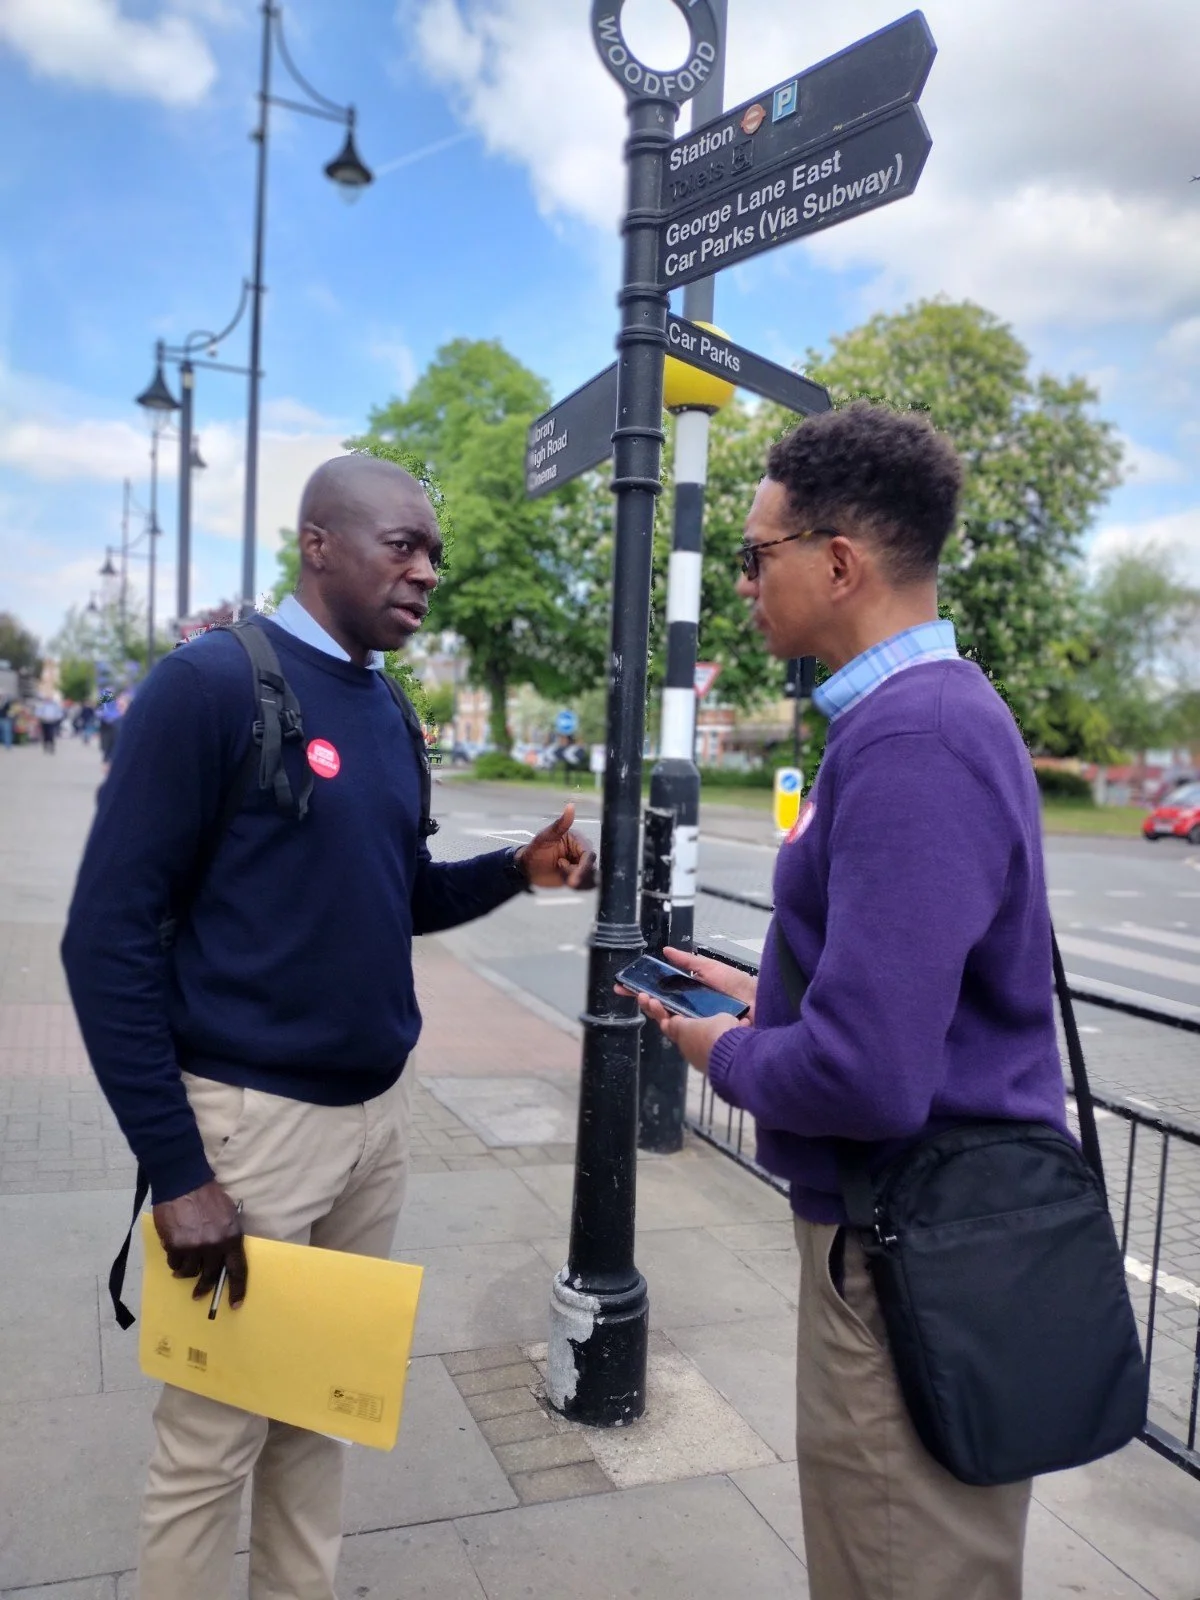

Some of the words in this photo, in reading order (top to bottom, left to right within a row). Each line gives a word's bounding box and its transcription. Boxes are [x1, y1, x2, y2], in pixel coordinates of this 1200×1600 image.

[598, 16, 716, 97] WOODFORD
[669, 126, 734, 171] Station
[777, 86, 792, 117] P
[665, 250, 697, 277] Car
[701, 226, 754, 263] Parks
[760, 206, 798, 240] (Via
[803, 153, 903, 219] Subway)
[666, 204, 732, 246] George
[737, 179, 786, 216] Lane
[792, 150, 842, 192] East
[669, 322, 697, 351] Car
[701, 336, 740, 372] Parks
[547, 429, 568, 458] Road
